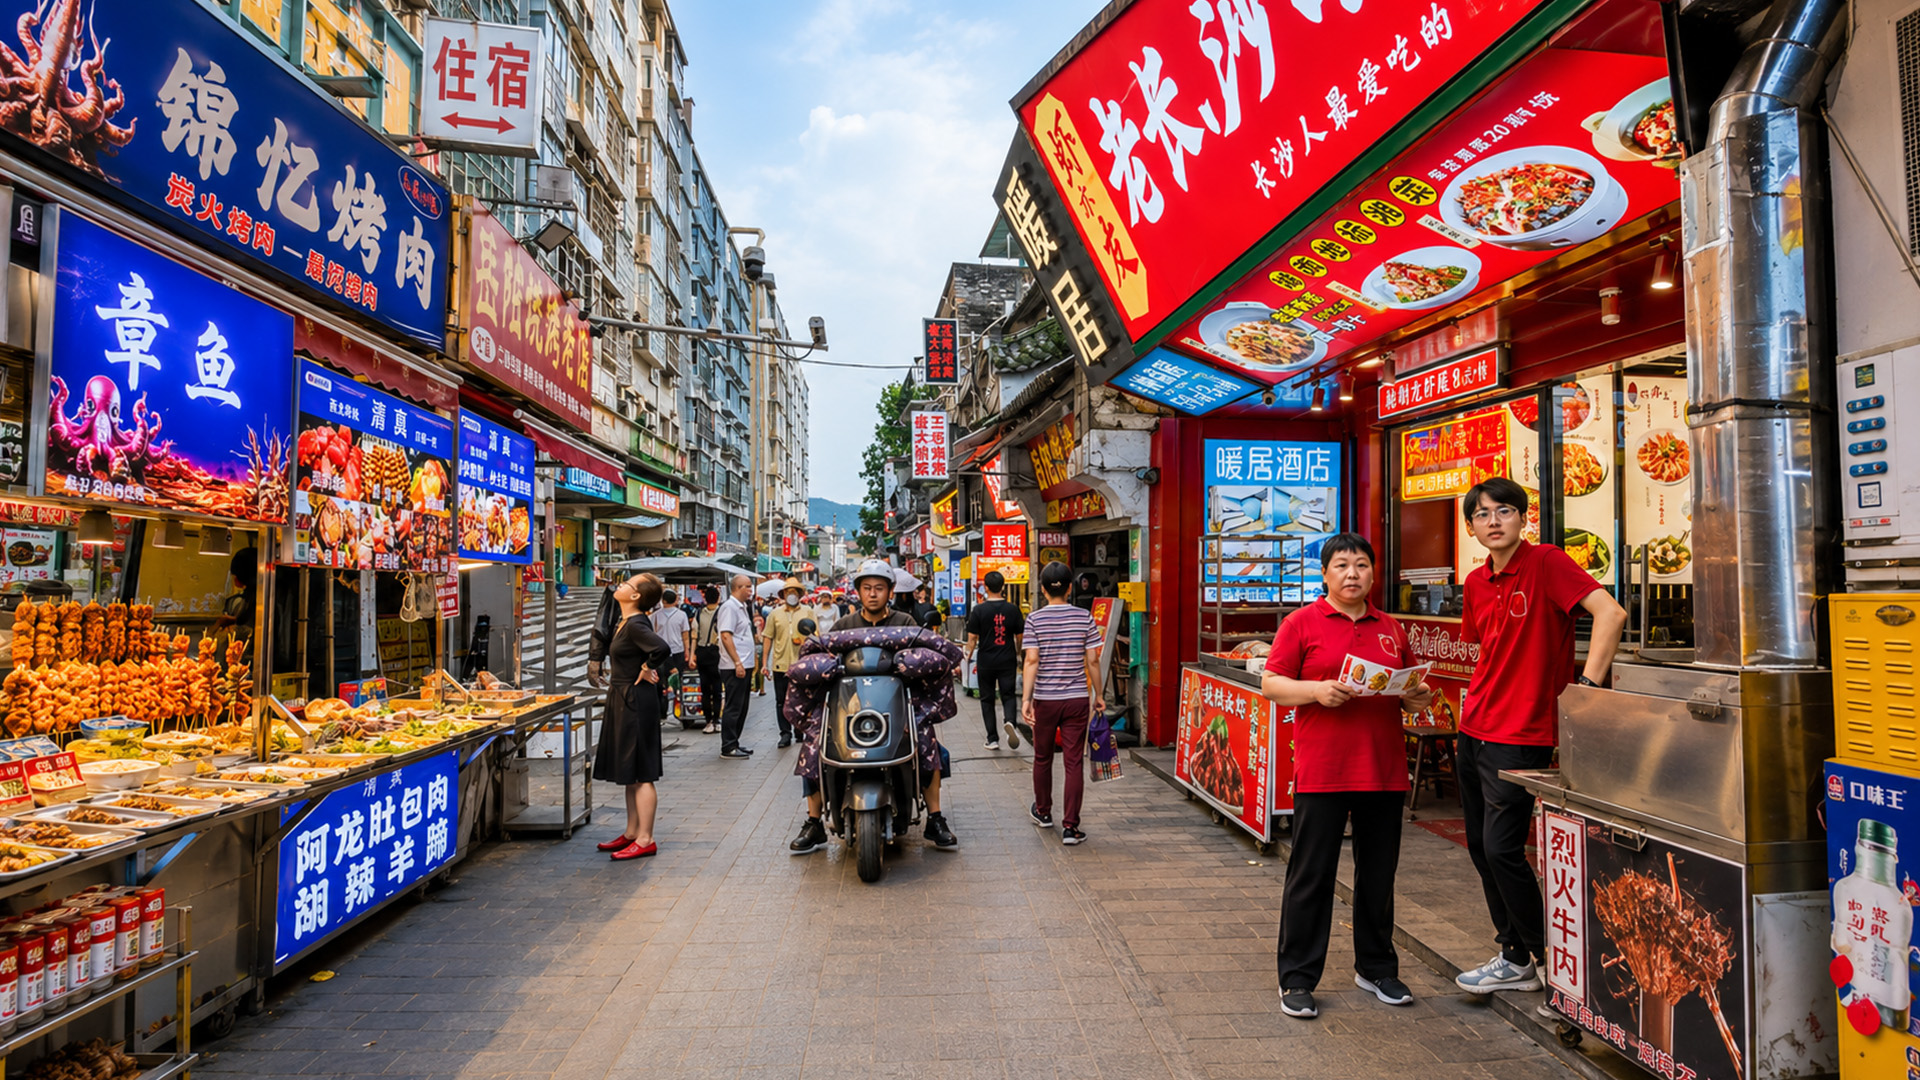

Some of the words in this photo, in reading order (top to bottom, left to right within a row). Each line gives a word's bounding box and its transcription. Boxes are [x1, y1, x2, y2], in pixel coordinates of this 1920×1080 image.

[433, 36, 531, 109] 住宿
[1089, 0, 1365, 228] 老长沙
[1250, 2, 1452, 199] 长沙人最爱吃的
[156, 47, 437, 301] 锦忆烤肉
[165, 172, 276, 257] 炭火烤肉
[1004, 166, 1107, 366] 暖居
[95, 271, 242, 410] 章鱼
[1216, 447, 1331, 482] 暖居酒店
[296, 773, 448, 884] 阿龙肚包肉
[1850, 781, 1904, 811] 口味王
[294, 817, 448, 941] 胡辣羊蹄
